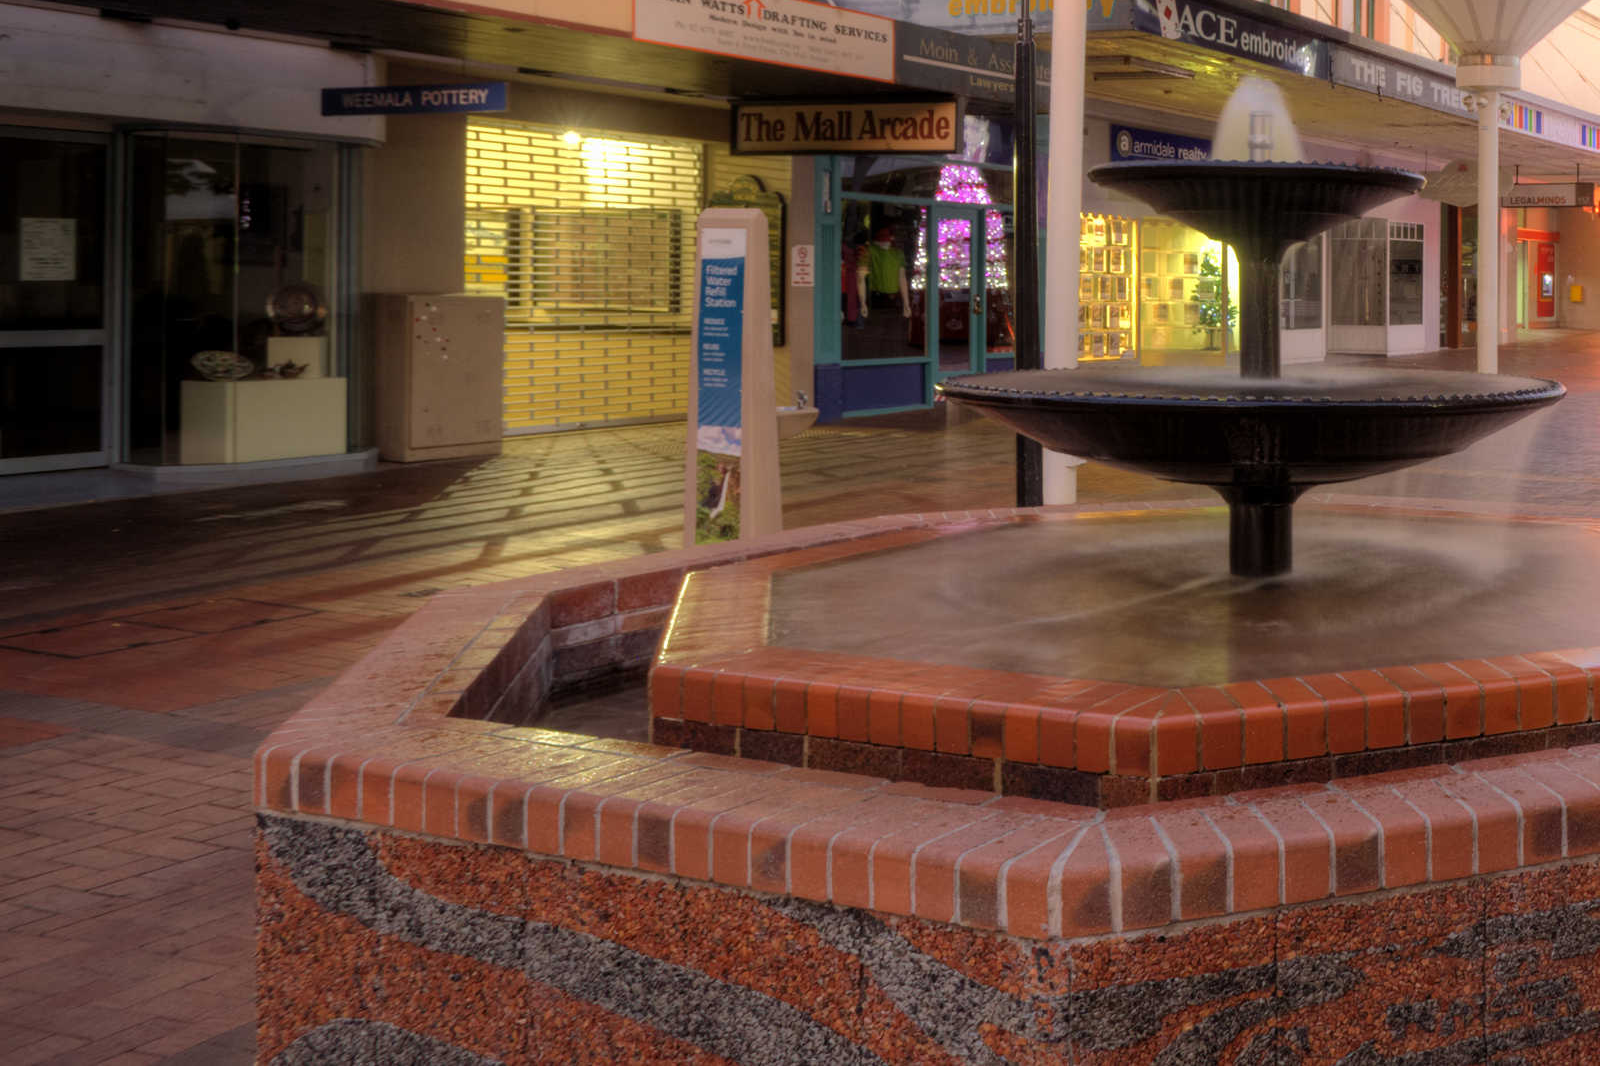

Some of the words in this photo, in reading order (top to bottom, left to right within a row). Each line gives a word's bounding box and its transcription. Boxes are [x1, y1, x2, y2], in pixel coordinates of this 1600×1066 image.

[763, 9, 827, 32] DRAFTING
[834, 24, 888, 44] SERVICES
[1176, 5, 1238, 48] ACE
[967, 46, 977, 67] &
[1351, 58, 1386, 89] THE
[1395, 70, 1423, 97] FIG
[343, 92, 413, 109] WEEMALA
[421, 88, 489, 106] POTTERY
[741, 112, 785, 142] The
[792, 110, 854, 142] Mall
[856, 109, 950, 141] Arcade
[1133, 140, 1176, 158] armidale
[1178, 146, 1208, 160] realty
[1510, 196, 1567, 205] LEGALMINDS
[706, 277, 732, 287] Water
[704, 297, 737, 308] Station
